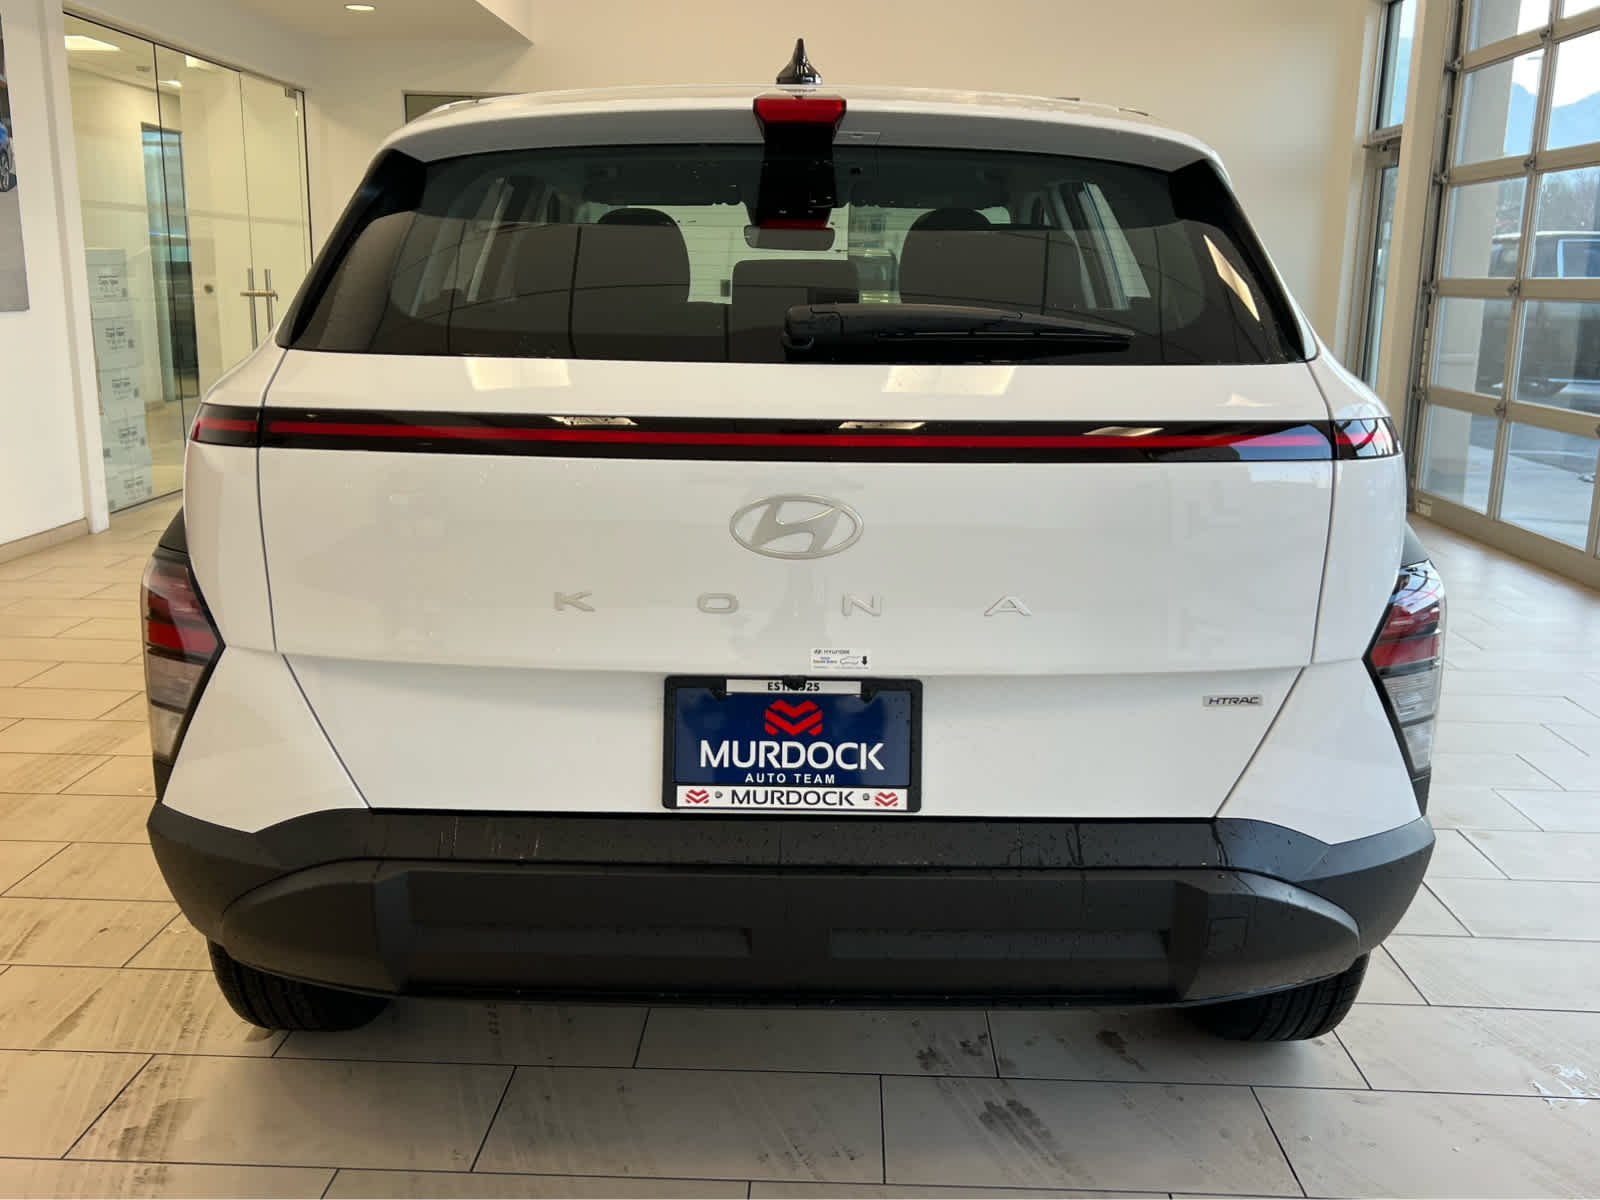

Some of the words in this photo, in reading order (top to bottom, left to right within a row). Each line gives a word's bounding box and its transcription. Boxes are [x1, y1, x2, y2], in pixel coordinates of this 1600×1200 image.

[552, 591, 1033, 617] KONA
[1208, 696, 1260, 705] HTRAC
[700, 740, 885, 770] MURDOCK
[745, 773, 787, 784] AUTO
[795, 773, 836, 785] TEAM
[731, 789, 855, 807] MURDOCK
